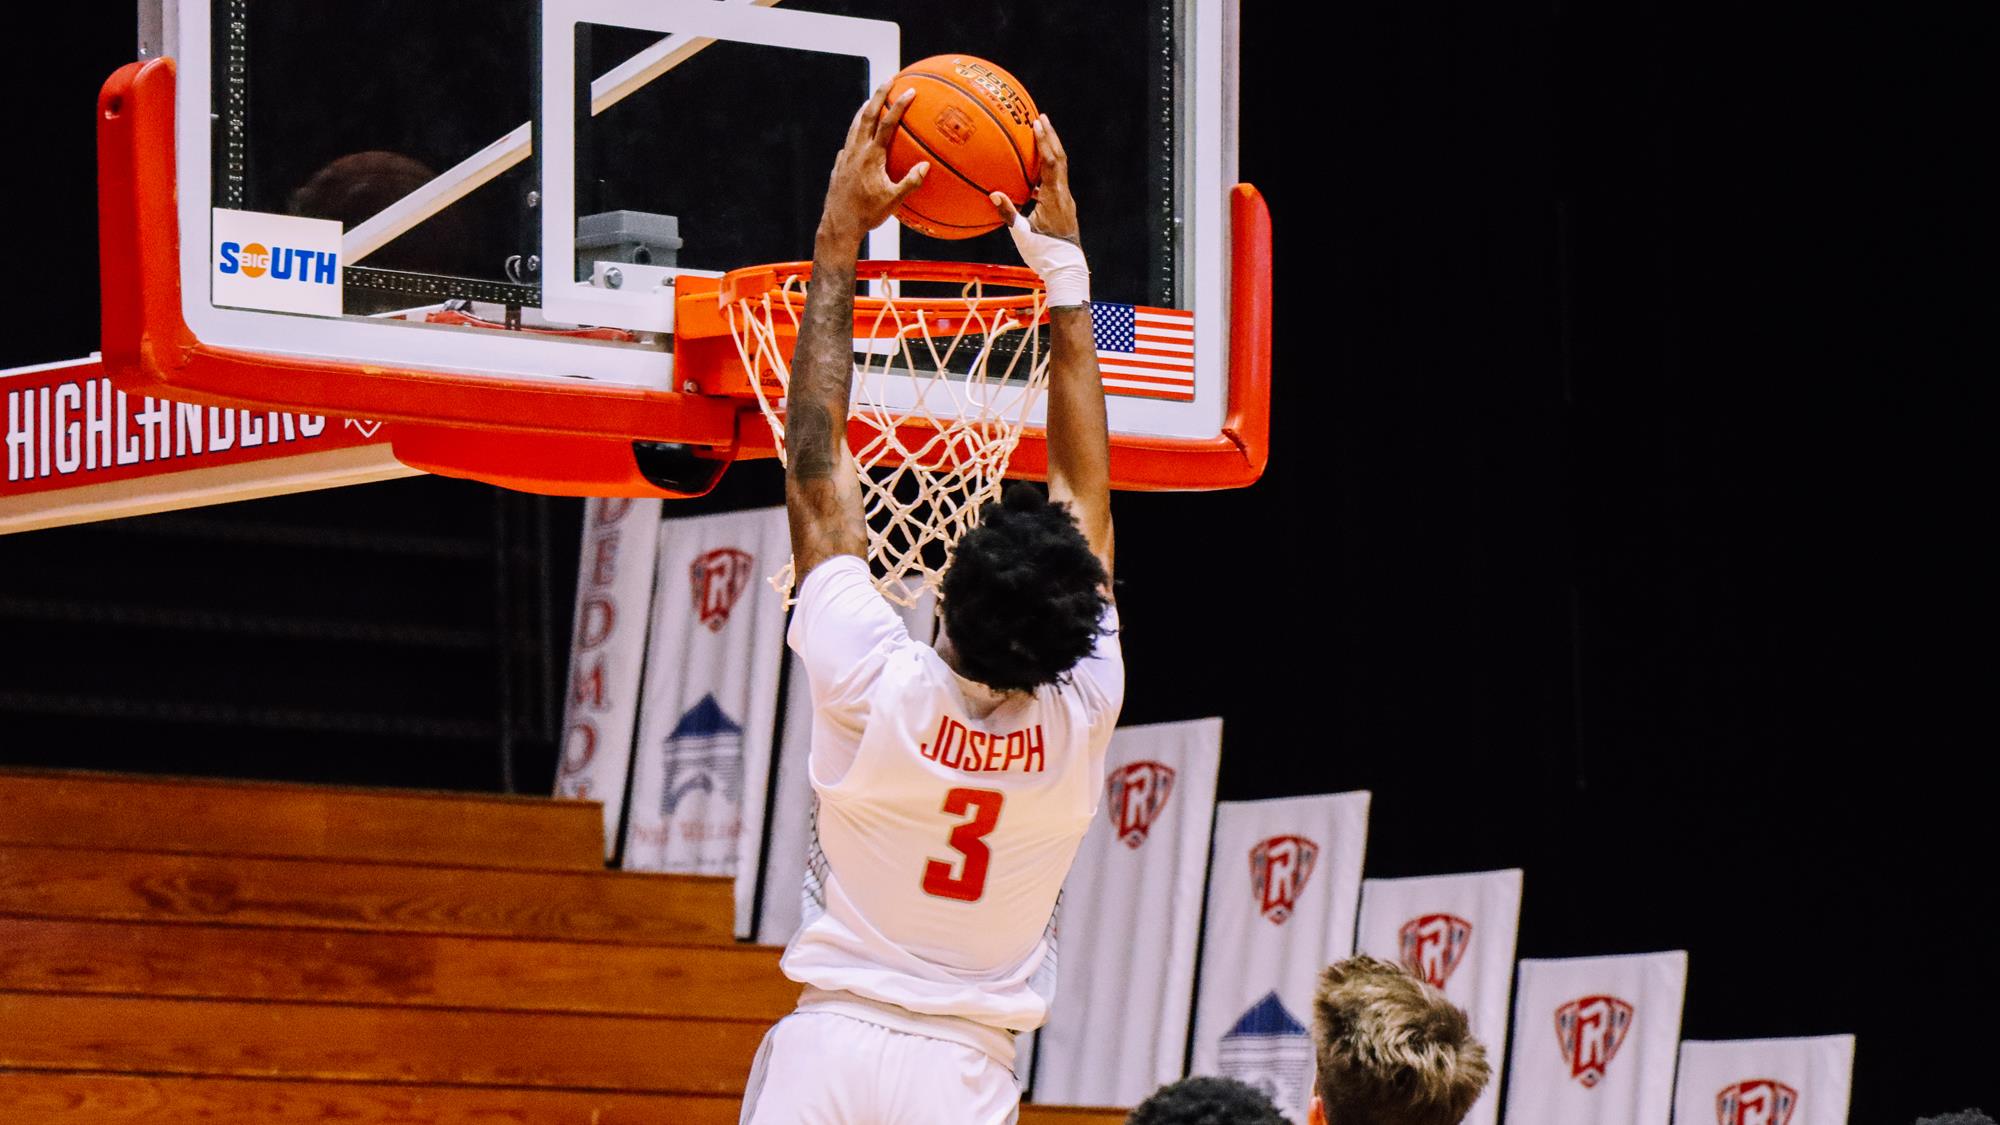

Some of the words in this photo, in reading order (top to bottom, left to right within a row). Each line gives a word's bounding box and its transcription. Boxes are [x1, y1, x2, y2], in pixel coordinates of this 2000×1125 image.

[240, 252, 271, 269] BIG
[5, 377, 326, 481] HIGHLAND
[556, 497, 633, 799] DEDMO
[920, 715, 1045, 773] JOSEPH
[920, 786, 1005, 904] 3
